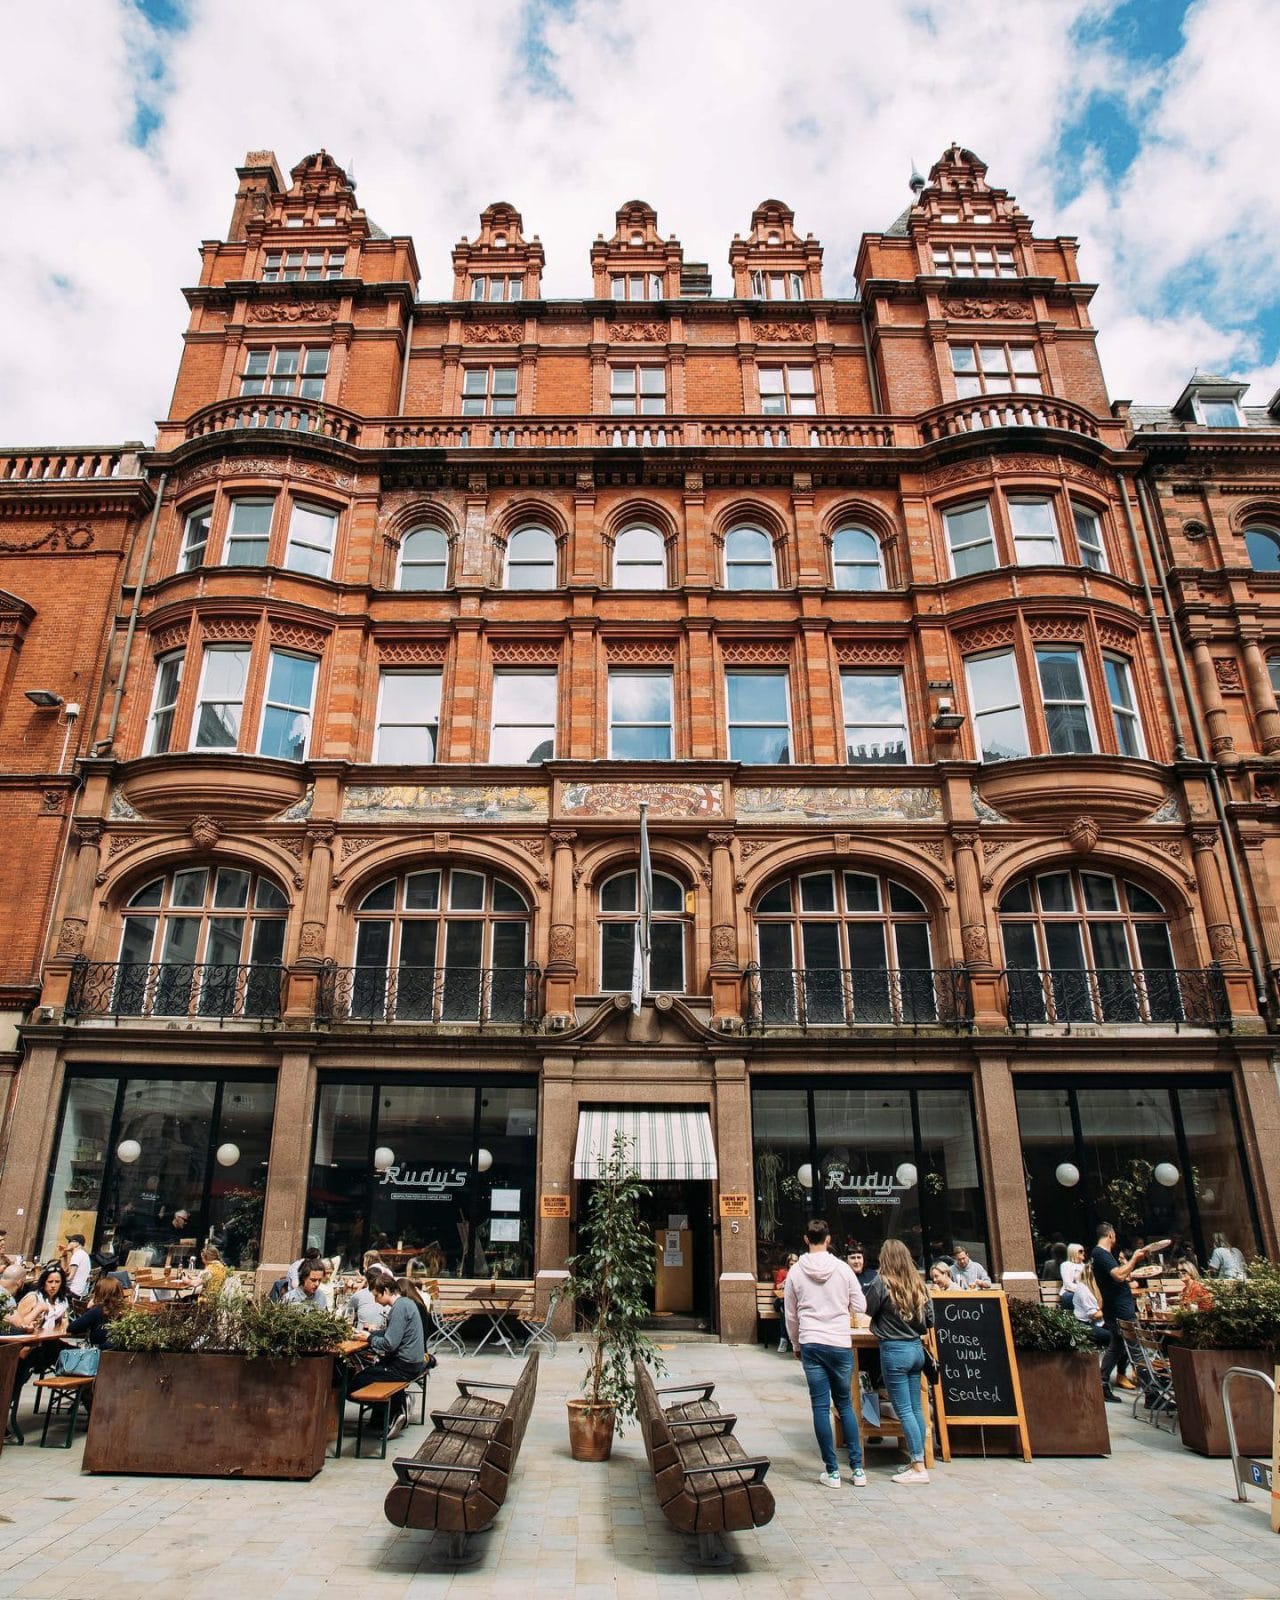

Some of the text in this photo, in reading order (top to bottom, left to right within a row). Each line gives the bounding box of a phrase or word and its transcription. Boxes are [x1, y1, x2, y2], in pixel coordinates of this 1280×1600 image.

[379, 1166, 467, 1191] Rudy's
[731, 1221, 739, 1234] 5
[937, 1328, 980, 1346] Please
[945, 1363, 982, 1379] to be
[948, 1385, 1002, 1403] Seated
